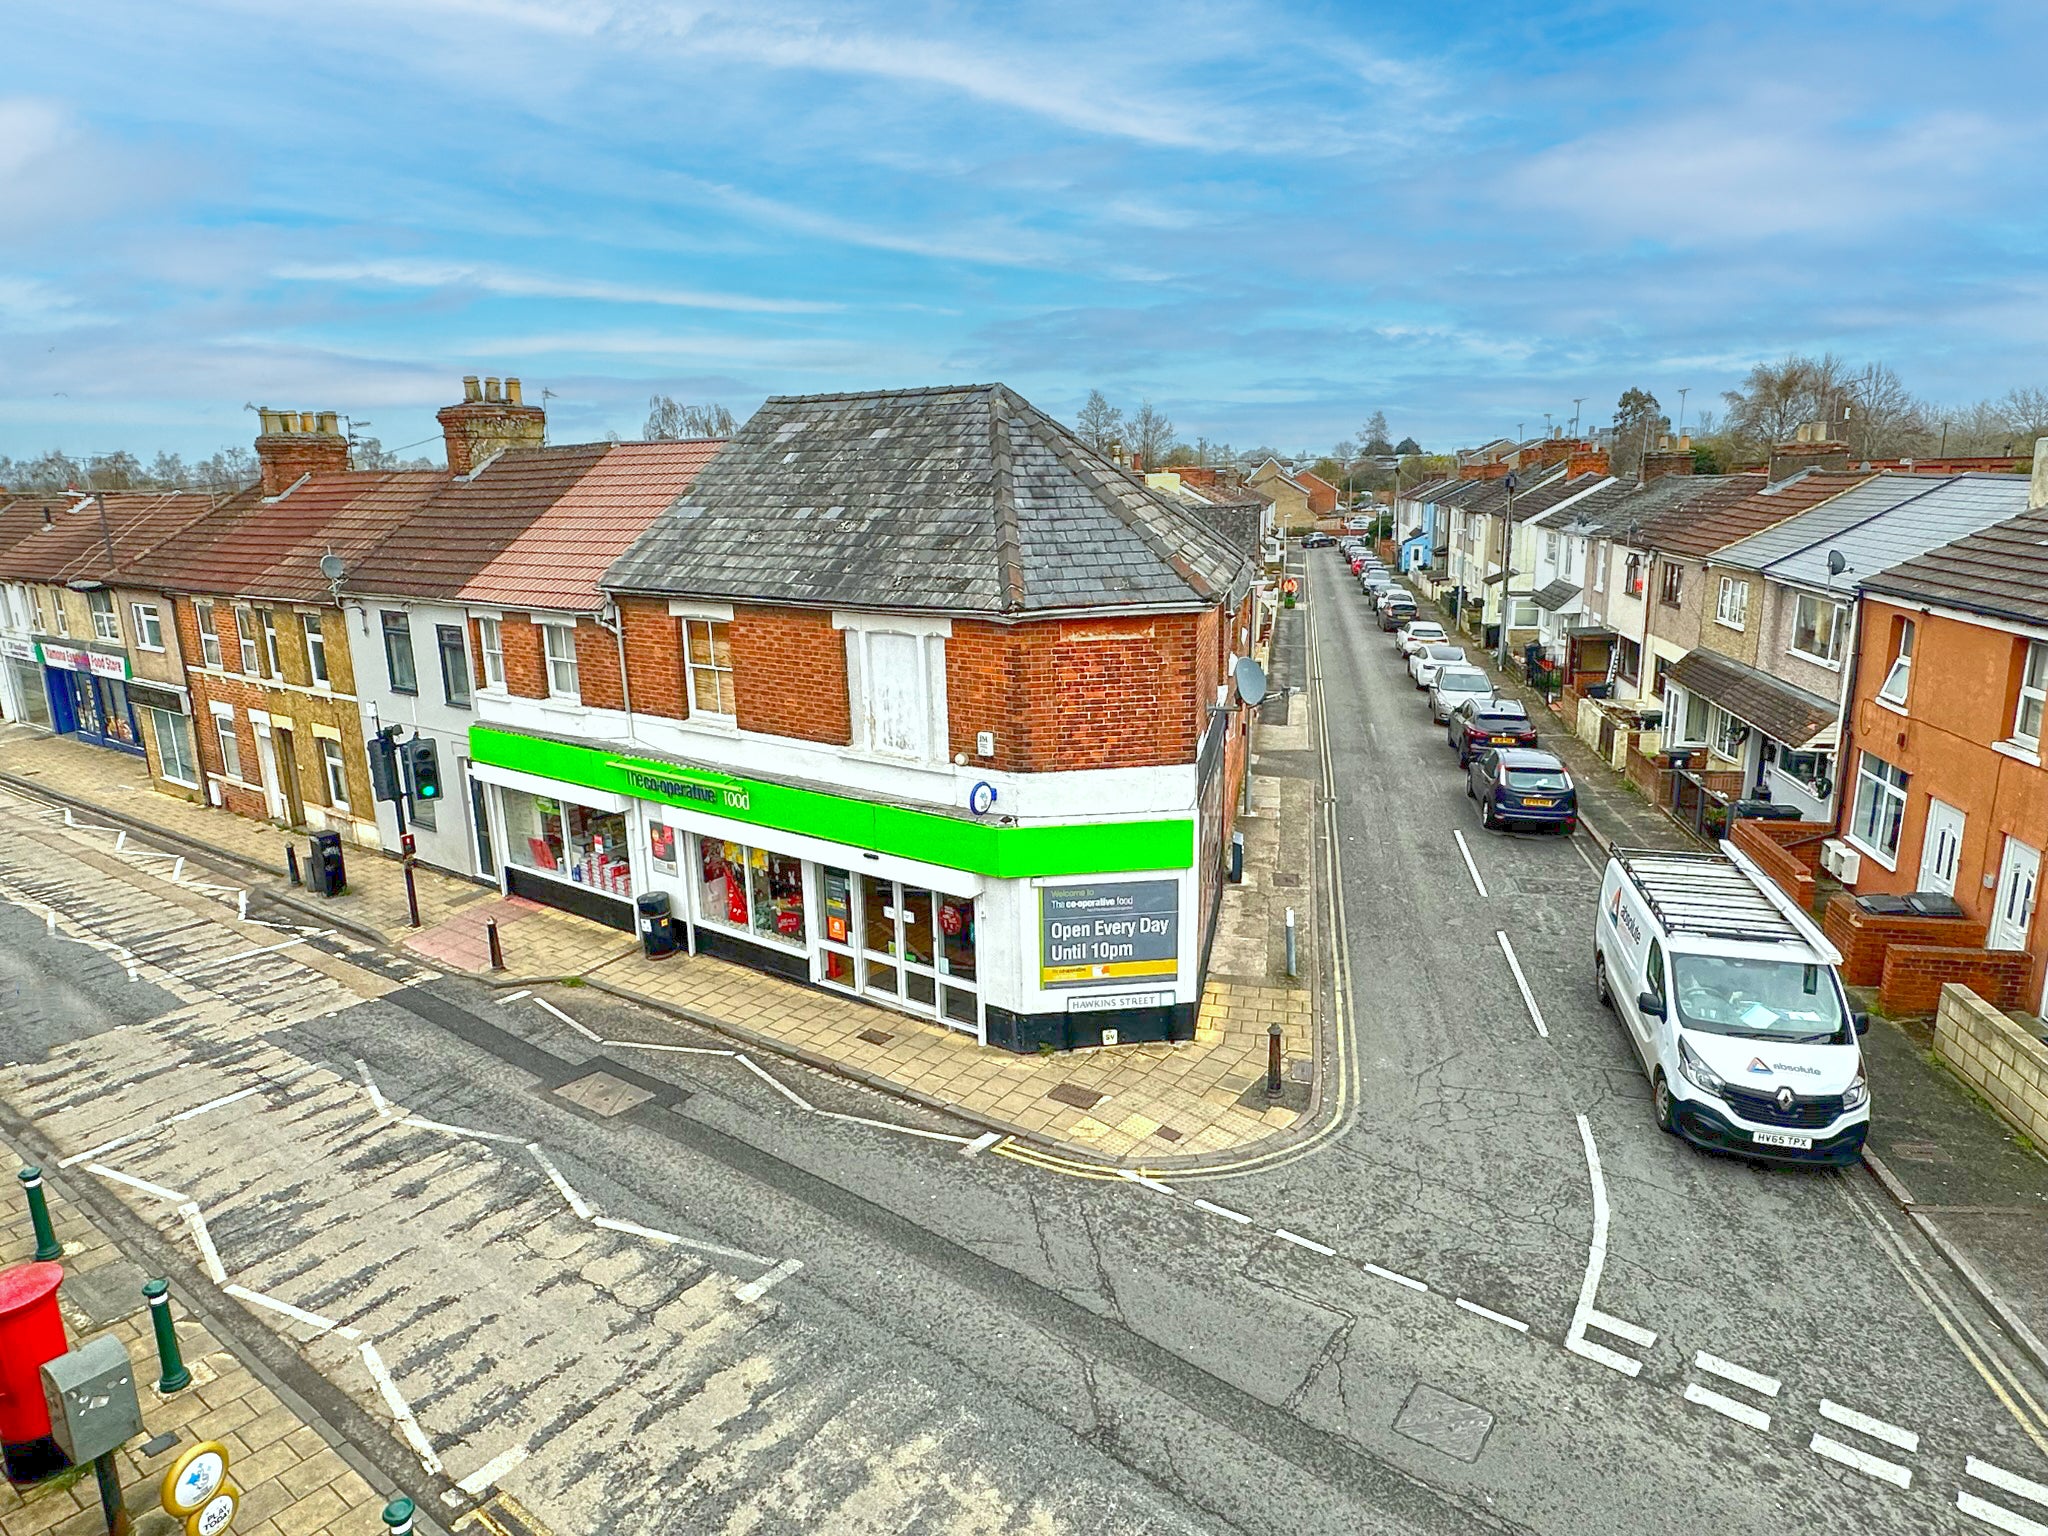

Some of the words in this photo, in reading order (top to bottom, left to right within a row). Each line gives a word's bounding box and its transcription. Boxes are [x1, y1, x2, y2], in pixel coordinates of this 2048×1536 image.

[644, 774, 717, 804] co-operative
[1051, 888, 1086, 897] Welcome
[1051, 900, 1065, 909] The
[1065, 897, 1116, 909] co-operative
[1116, 896, 1134, 905] food
[1051, 922, 1091, 941] Open
[1094, 919, 1137, 938] Every
[1139, 917, 1169, 935] Day
[1621, 905, 1641, 945] absolute
[1051, 943, 1087, 961] Until
[1090, 942, 1133, 960] 10pm
[1072, 998, 1117, 1010] HAWKINS
[1119, 996, 1156, 1007] STREET
[1773, 1062, 1822, 1076] absolute
[1758, 1133, 1785, 1145] HV65
[1787, 1138, 1808, 1147] TPX
[204, 1508, 231, 1531] TODAY
[207, 1504, 229, 1523] PLAY
